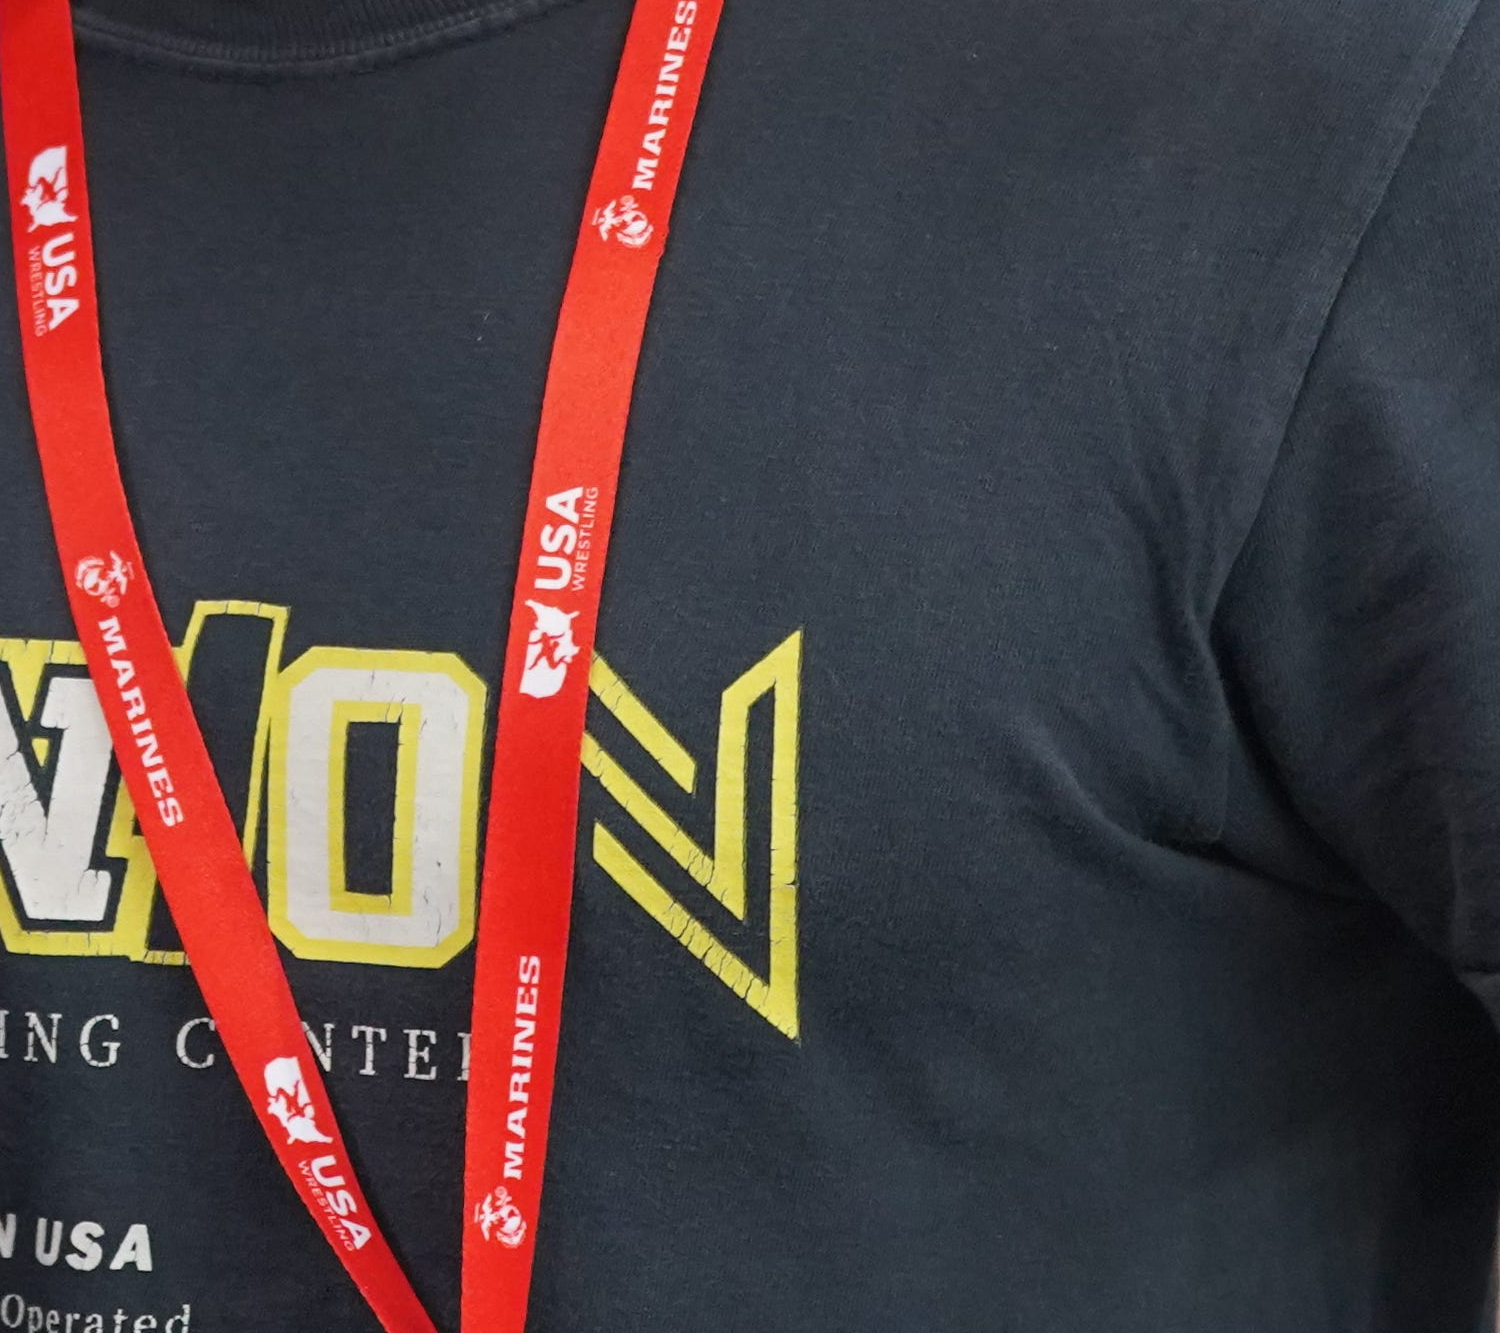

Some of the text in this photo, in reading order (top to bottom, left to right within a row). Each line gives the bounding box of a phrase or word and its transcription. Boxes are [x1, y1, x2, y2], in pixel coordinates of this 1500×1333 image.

[27, 245, 48, 338] WRESTLING
[41, 232, 81, 332] USA
[534, 486, 584, 590] USA
[571, 486, 599, 592] WRESTLING
[98, 614, 185, 828] MARINES
[176, 1017, 470, 1082] CNTE
[503, 954, 541, 1181] MARINES
[34, 1219, 154, 1272] USA
[298, 1159, 356, 1252] WRESTLING
[313, 1154, 373, 1251] USA
[0, 1293, 192, 1333] Operated
